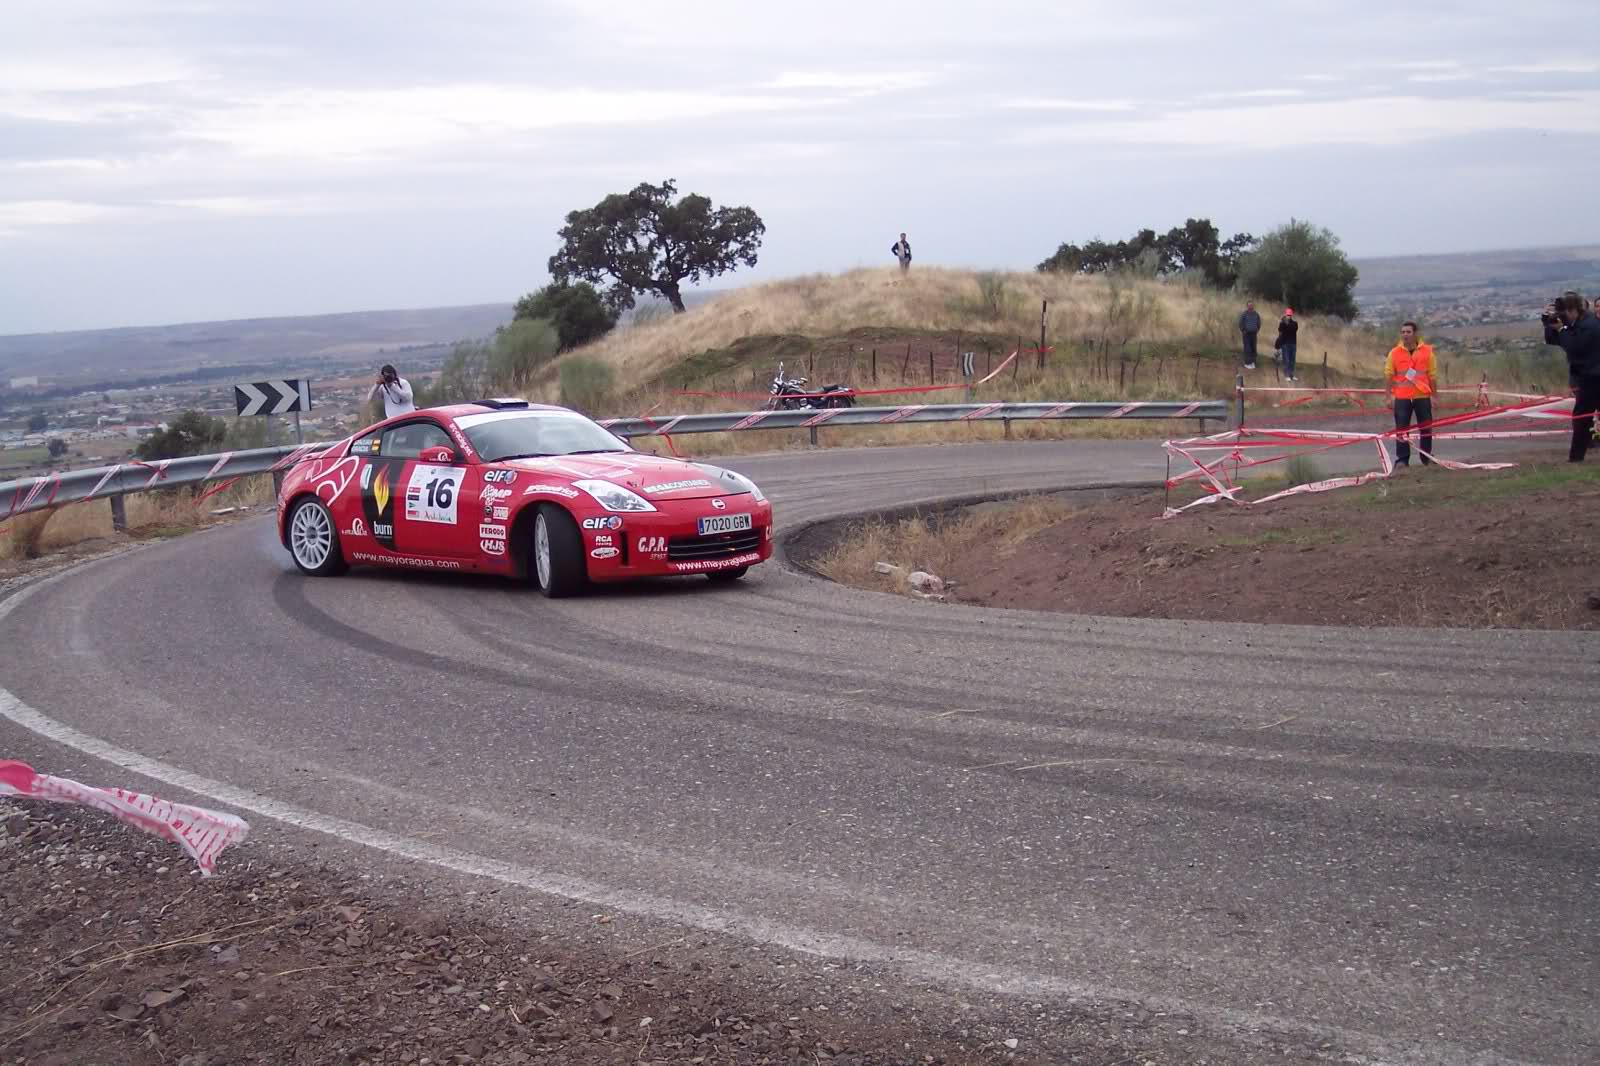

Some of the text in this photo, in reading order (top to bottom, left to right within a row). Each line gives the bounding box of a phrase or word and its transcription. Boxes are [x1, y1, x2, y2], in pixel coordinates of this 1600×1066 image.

[484, 470, 506, 482] elf
[426, 478, 455, 508] 16
[374, 521, 393, 535] burn
[582, 518, 608, 529] elf
[705, 515, 750, 533] 7020 GBW
[484, 540, 505, 551] HJS
[638, 536, 668, 552] G.P.R.
